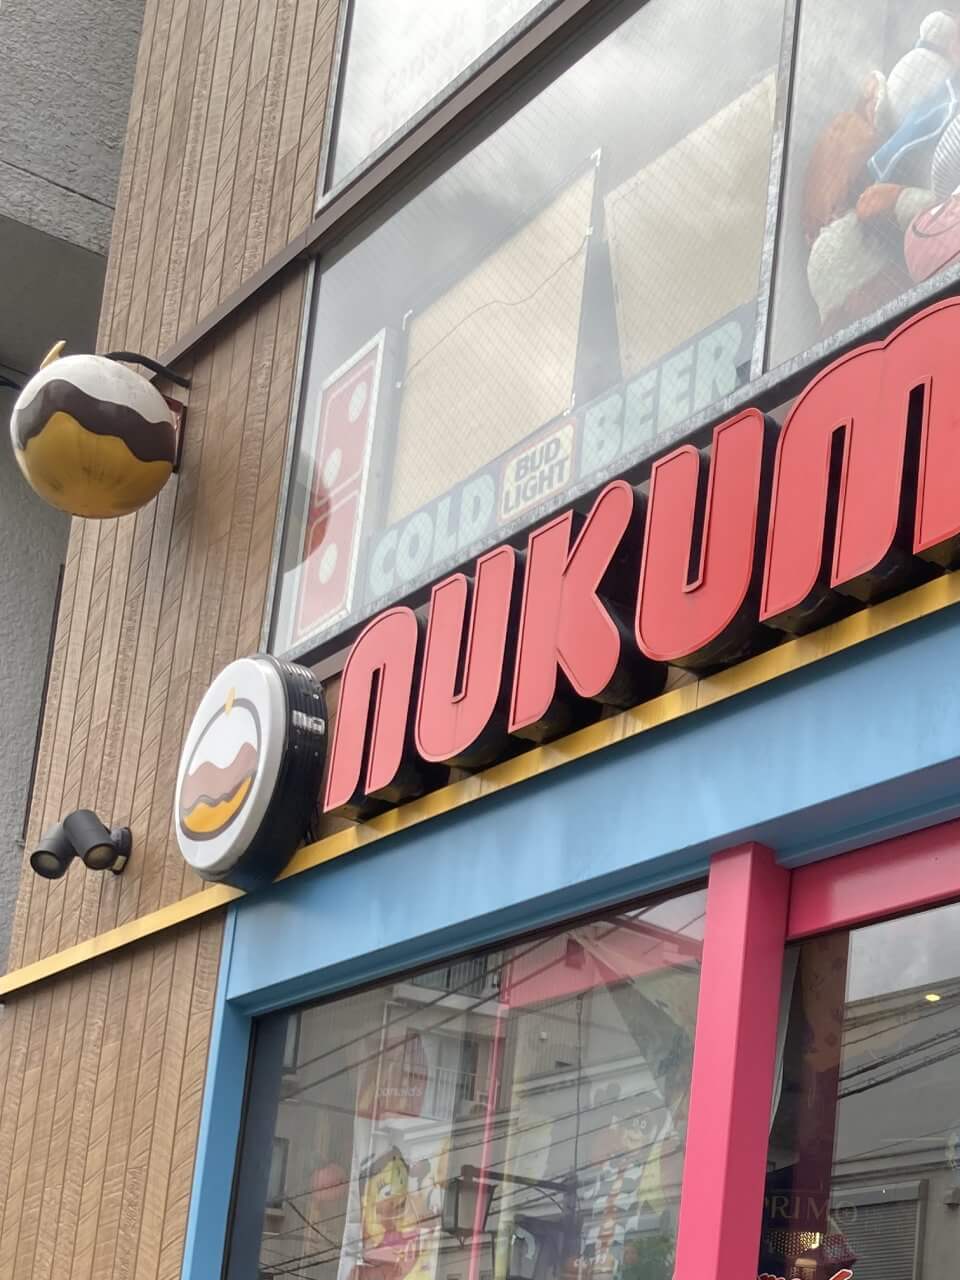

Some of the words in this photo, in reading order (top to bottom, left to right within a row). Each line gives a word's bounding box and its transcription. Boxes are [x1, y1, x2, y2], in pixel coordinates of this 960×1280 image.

[368, 473, 496, 597] COLD
[580, 320, 743, 478] BEER
[502, 457, 570, 514] LIGHT
[513, 436, 561, 482] BUD
